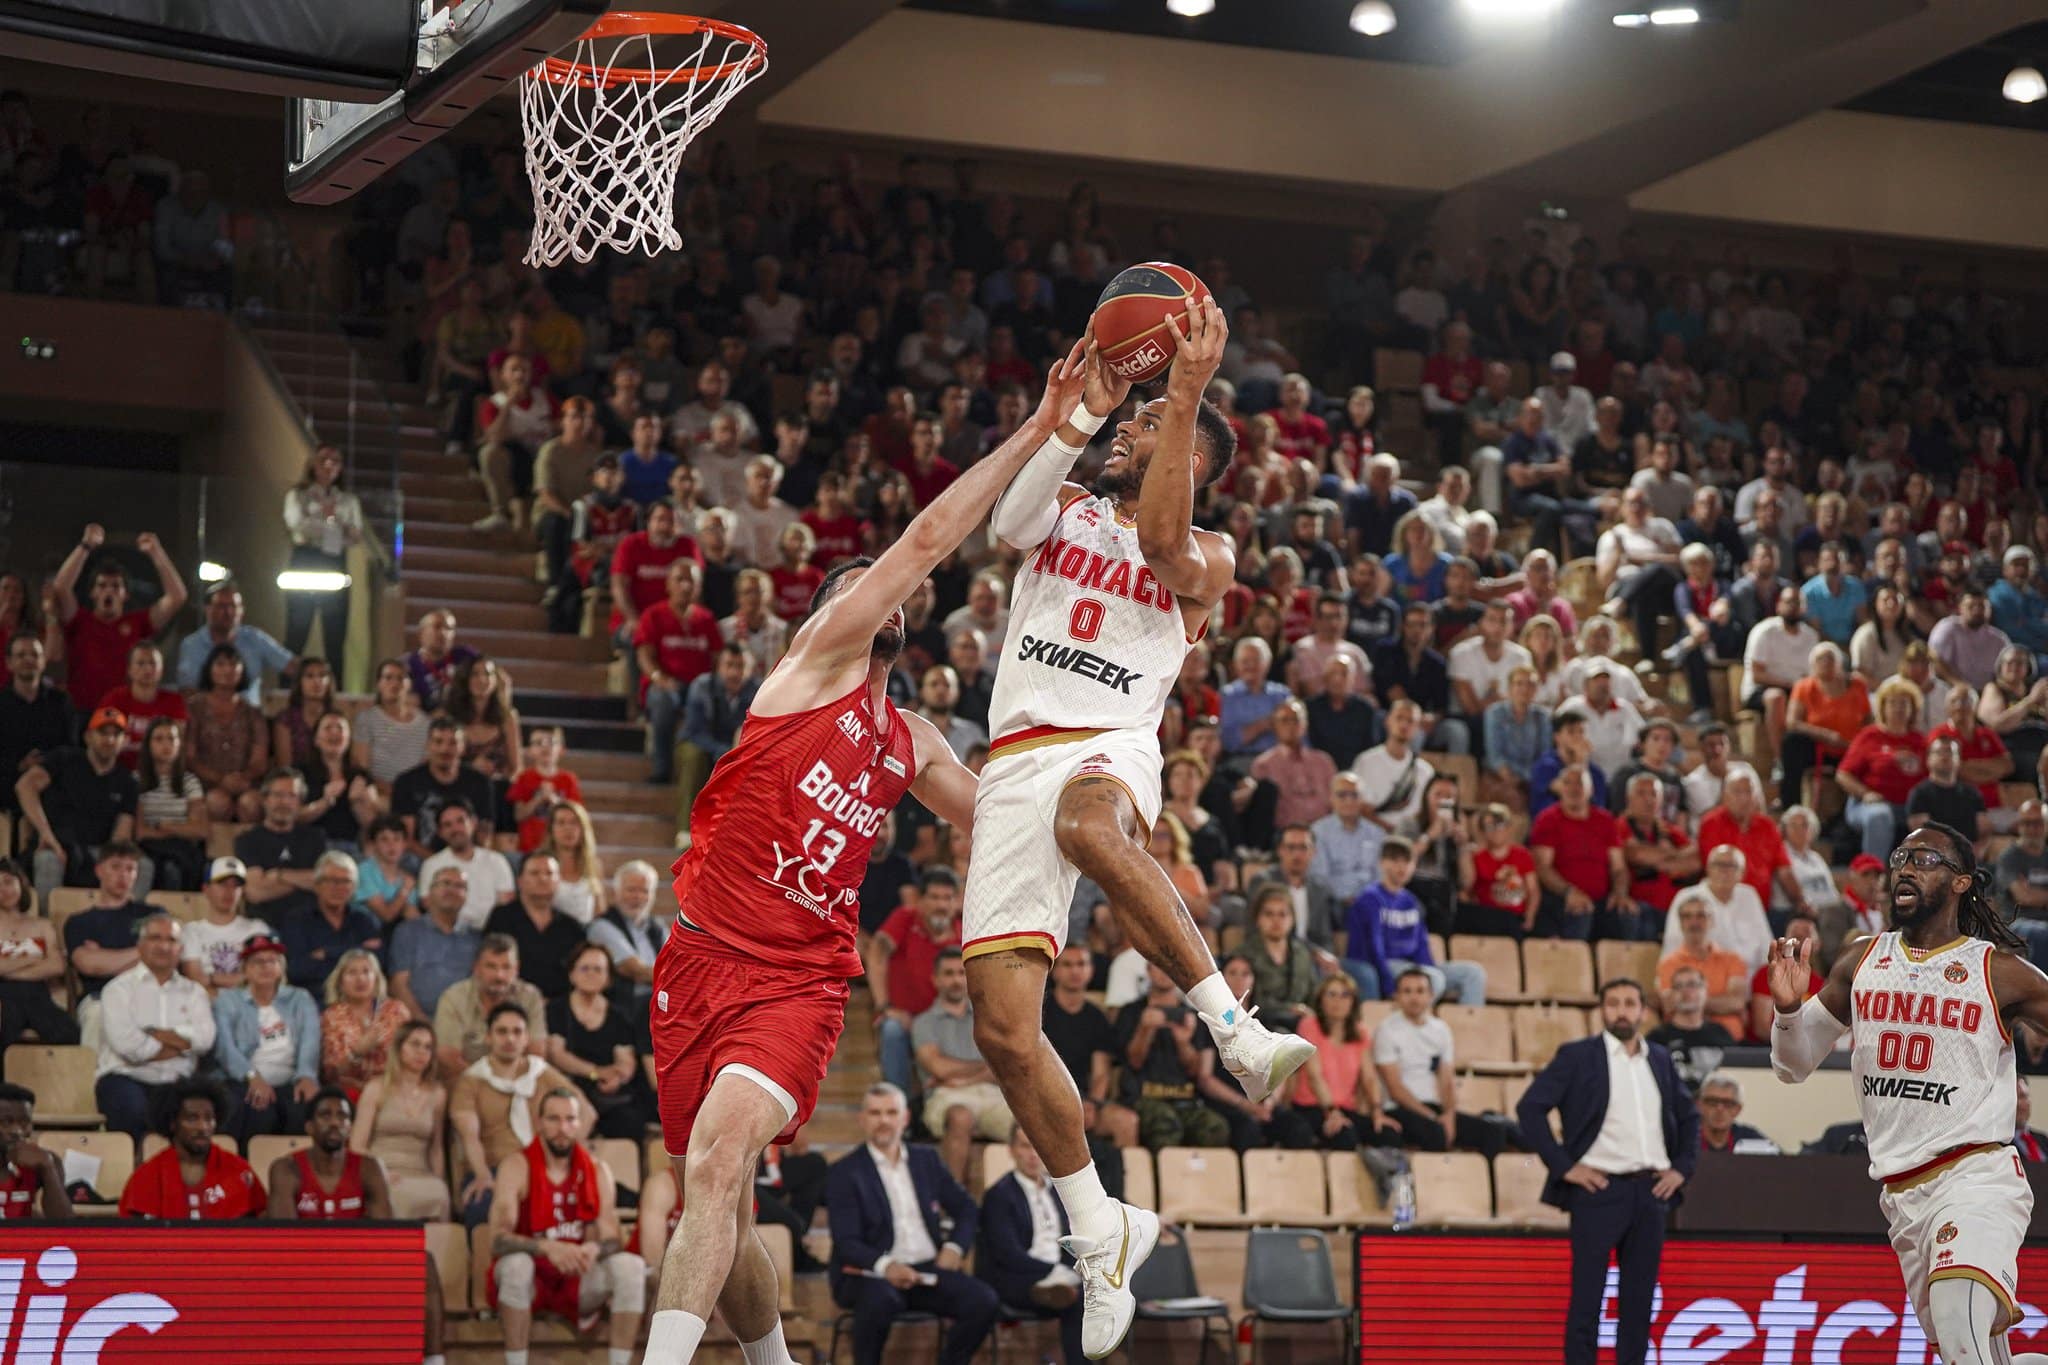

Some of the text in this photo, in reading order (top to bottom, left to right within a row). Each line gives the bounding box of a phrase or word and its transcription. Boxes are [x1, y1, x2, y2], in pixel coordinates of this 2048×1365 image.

[1032, 535, 1174, 614] MONACO
[1068, 597, 1106, 643] 0
[1018, 634, 1143, 695] SKWEEK
[835, 709, 862, 742] AIN
[797, 757, 887, 836] BOURG
[802, 818, 847, 876] 13
[1853, 988, 1983, 1035] MONACO
[1877, 1029, 1935, 1073] 00
[1862, 1074, 1960, 1107] SKWEEK
